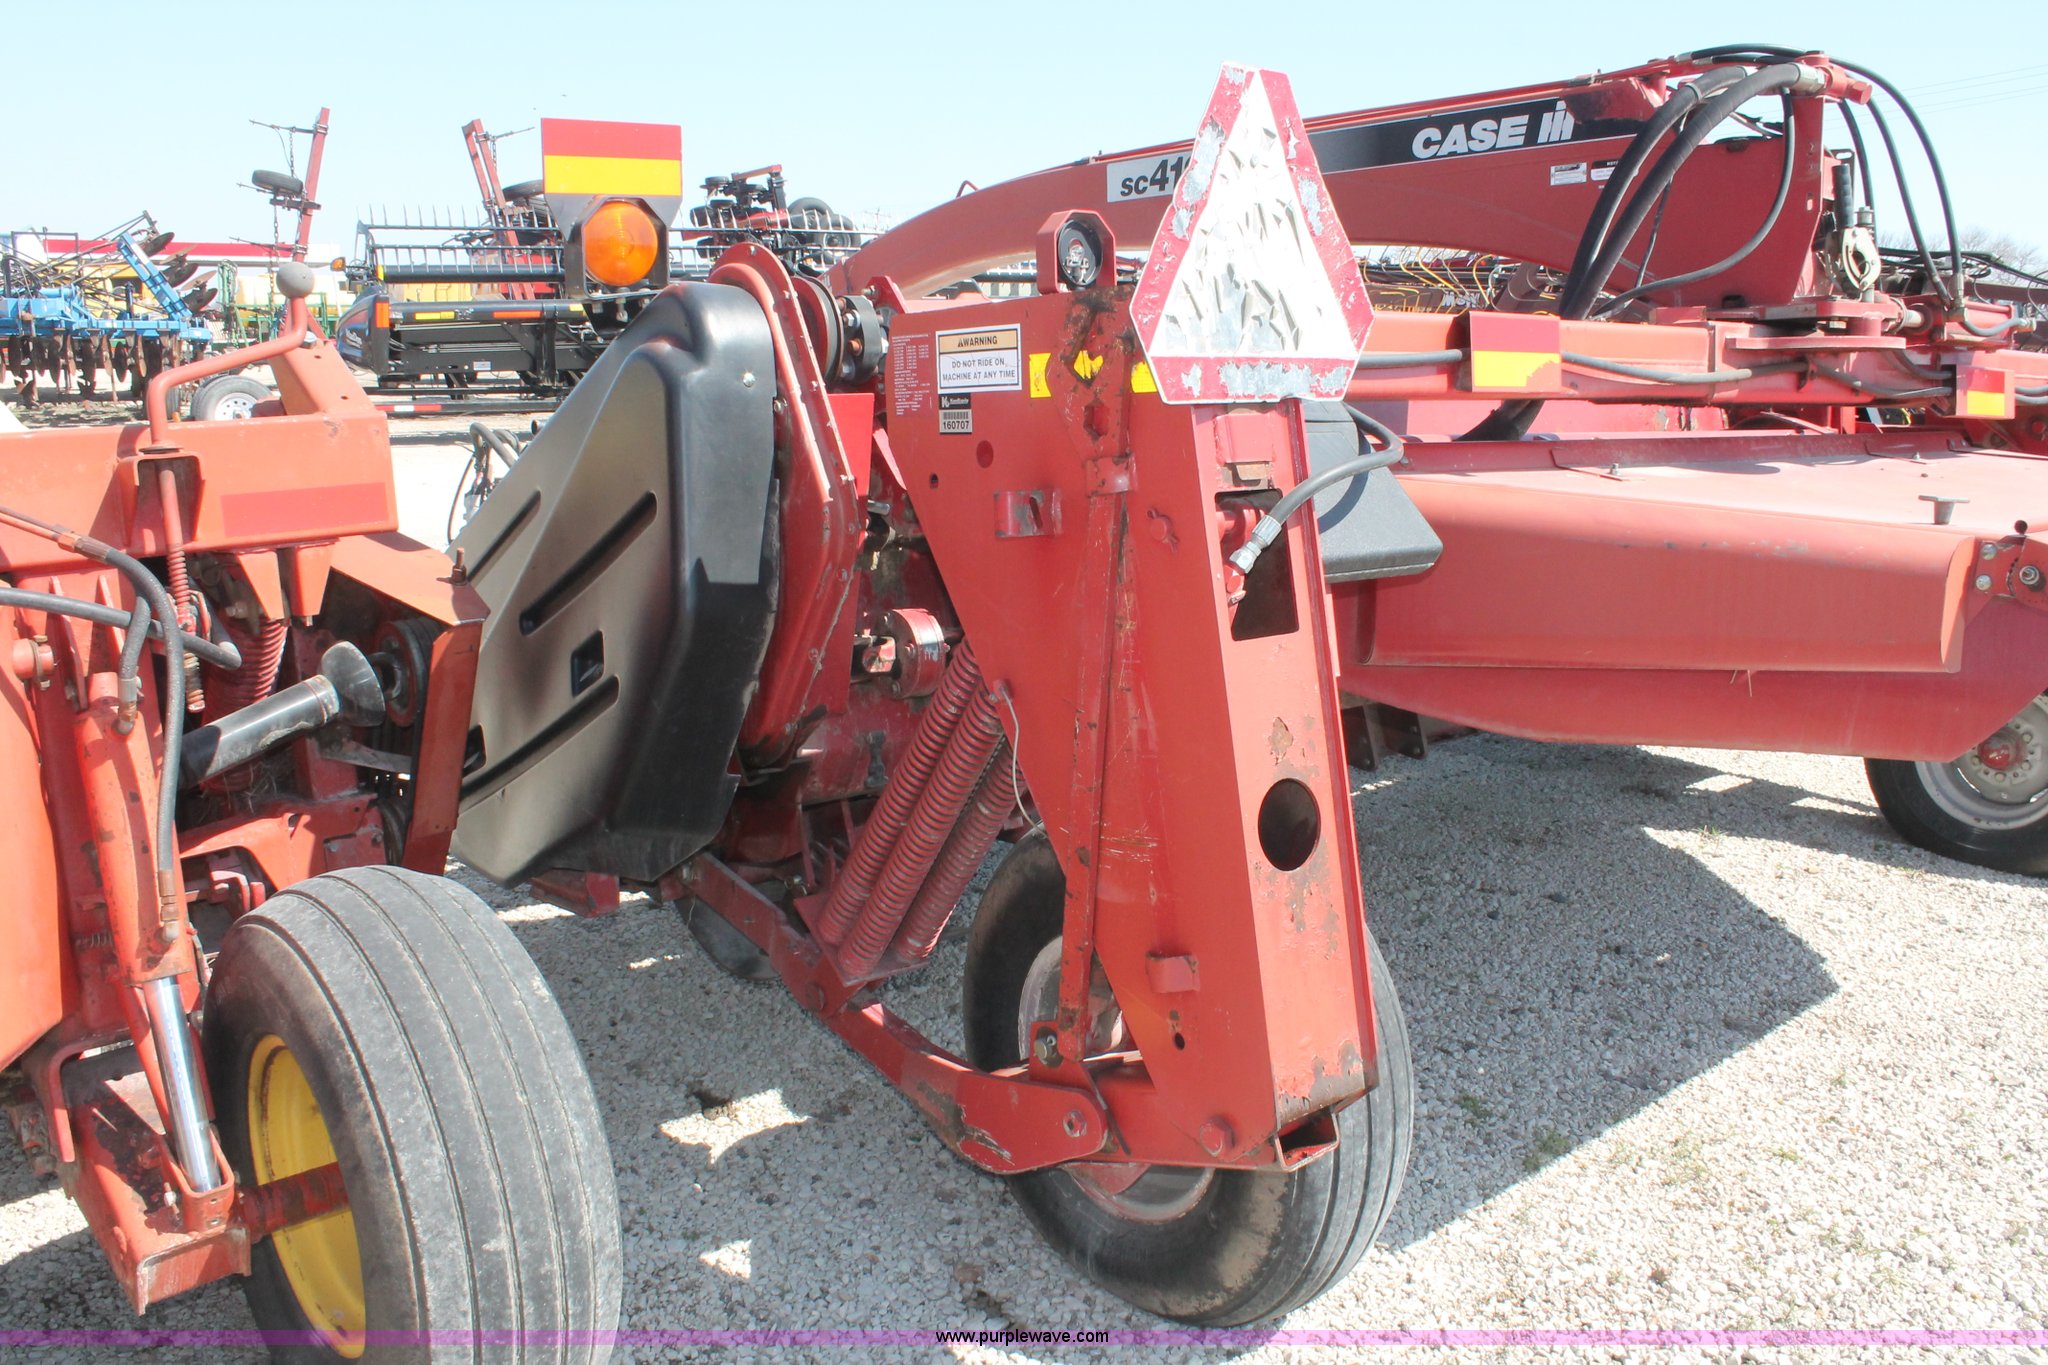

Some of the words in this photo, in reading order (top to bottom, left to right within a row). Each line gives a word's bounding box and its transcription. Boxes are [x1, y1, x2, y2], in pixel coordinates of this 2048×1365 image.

[1412, 114, 1530, 159] CASE
[1120, 156, 1192, 197] sc41
[963, 335, 998, 348] WARNING
[952, 361, 962, 369] DO
[962, 359, 976, 369] NOT
[977, 358, 993, 367] RIDE
[994, 358, 1005, 366] ON
[942, 371, 971, 382] MACHINE
[973, 371, 982, 380] AT
[983, 370, 997, 380] ANY
[999, 369, 1016, 379] TIME
[943, 420, 970, 430] 160707
